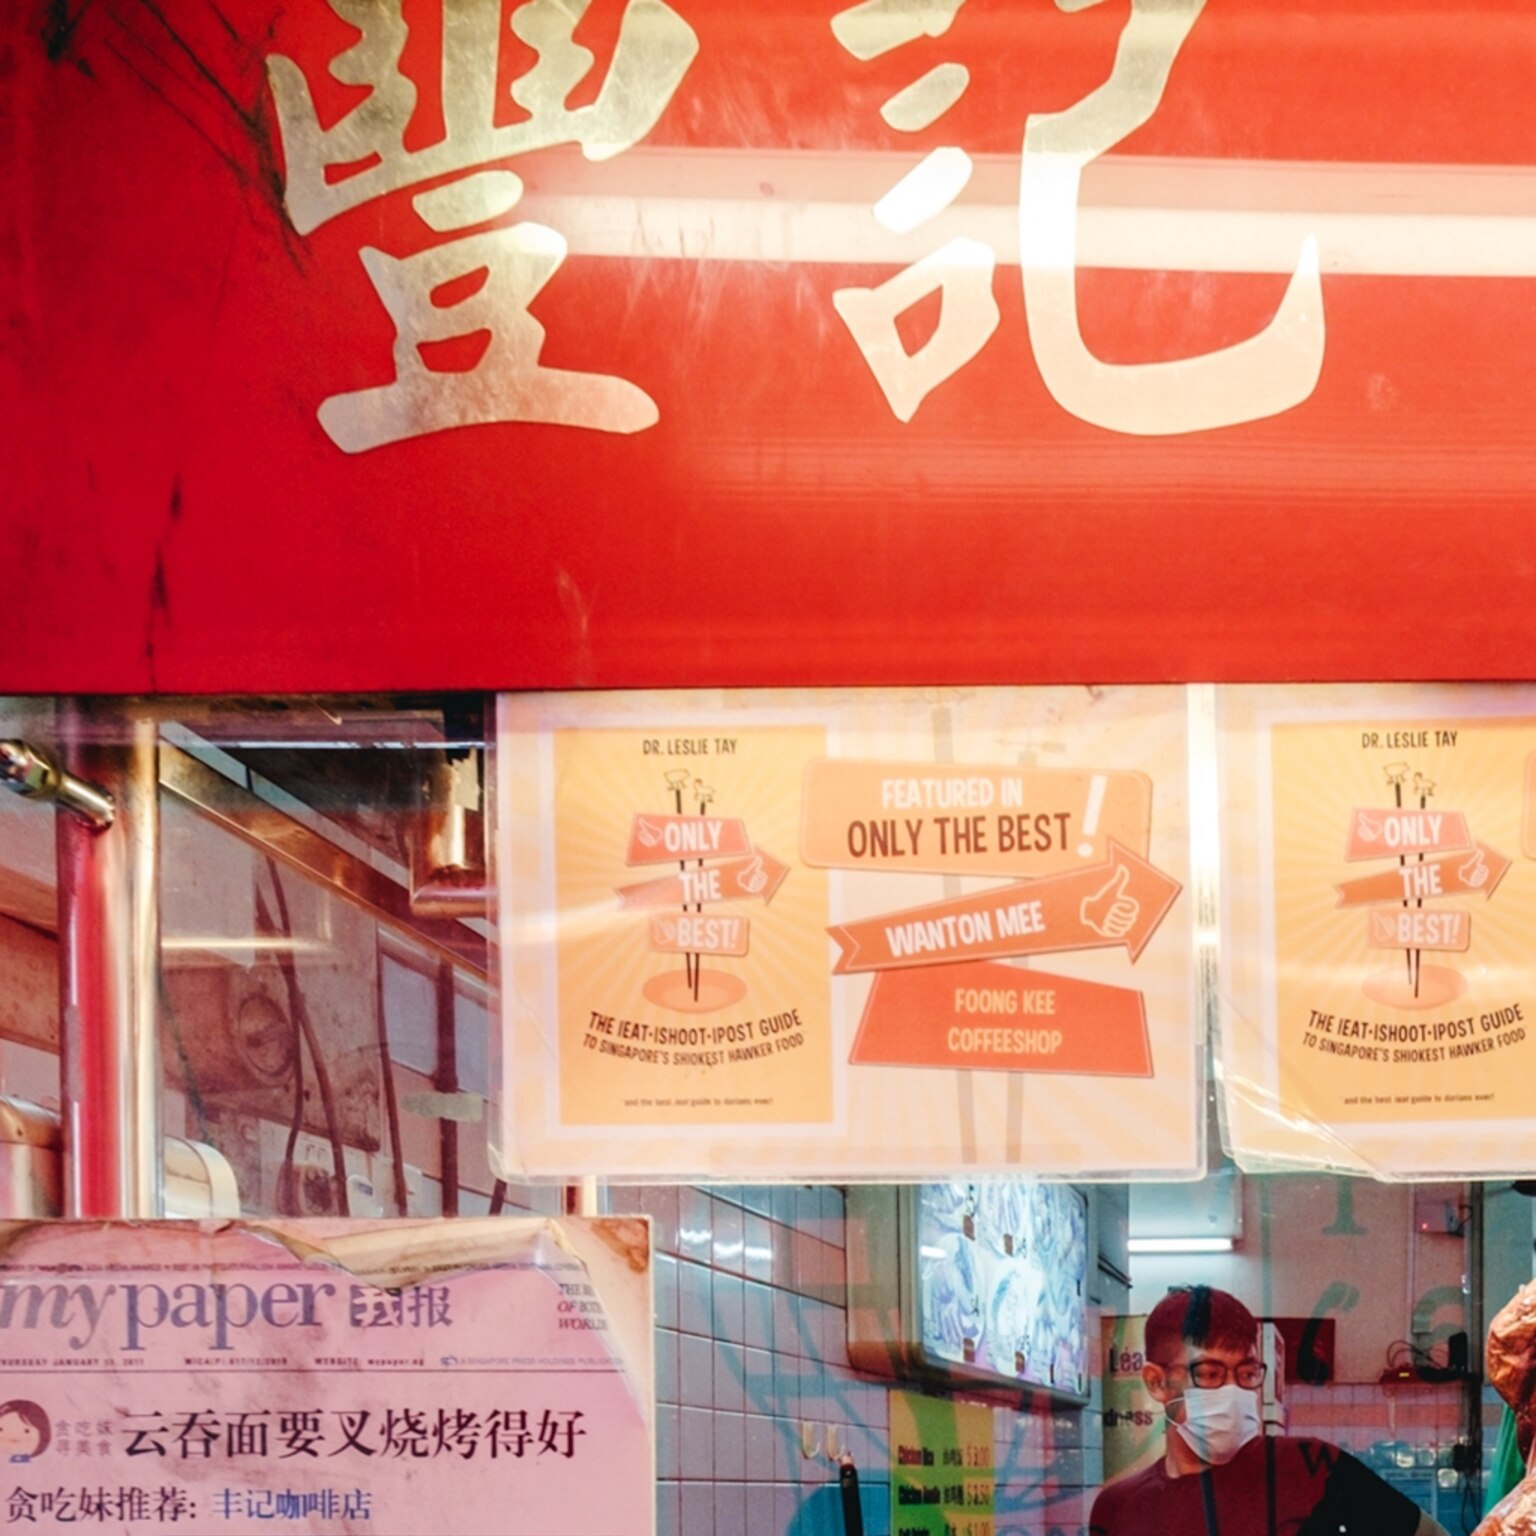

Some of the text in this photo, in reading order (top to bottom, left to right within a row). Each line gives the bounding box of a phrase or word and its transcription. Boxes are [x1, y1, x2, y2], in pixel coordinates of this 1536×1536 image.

[643, 739, 737, 755] DR. LESLIE TAY
[1362, 731, 1458, 749] DR. LESLIE TAY
[881, 778, 1023, 809] FEATURED IN
[664, 821, 722, 852] ONLY
[848, 818, 923, 858] ONLY
[934, 816, 987, 855] THE
[1384, 815, 1442, 847] ONLY
[679, 870, 721, 903] THE
[1398, 864, 1442, 898] THE
[677, 917, 740, 948] BEST!
[885, 900, 1045, 957] WANTON MEE
[1397, 913, 1460, 944] BEST!
[954, 989, 1055, 1015] FOONG KEE
[589, 1011, 613, 1035] THE
[759, 1009, 802, 1036] GUIDE
[1308, 1010, 1334, 1033] THE
[1480, 1004, 1524, 1033] GUIDE
[583, 1033, 804, 1066] TO SINGAPORE'S SHIOKEST HAWKER FOOD
[948, 1026, 1063, 1053] COFFEESHOP
[1303, 1028, 1526, 1063] TO SINGAPORE'S SHIOKEST HAWKER FOOD
[120, 1282, 336, 1350] paper
[121, 1408, 588, 1461] 云吞面要叉烧烤得好
[212, 1487, 372, 1521] 丰记咖啡店
